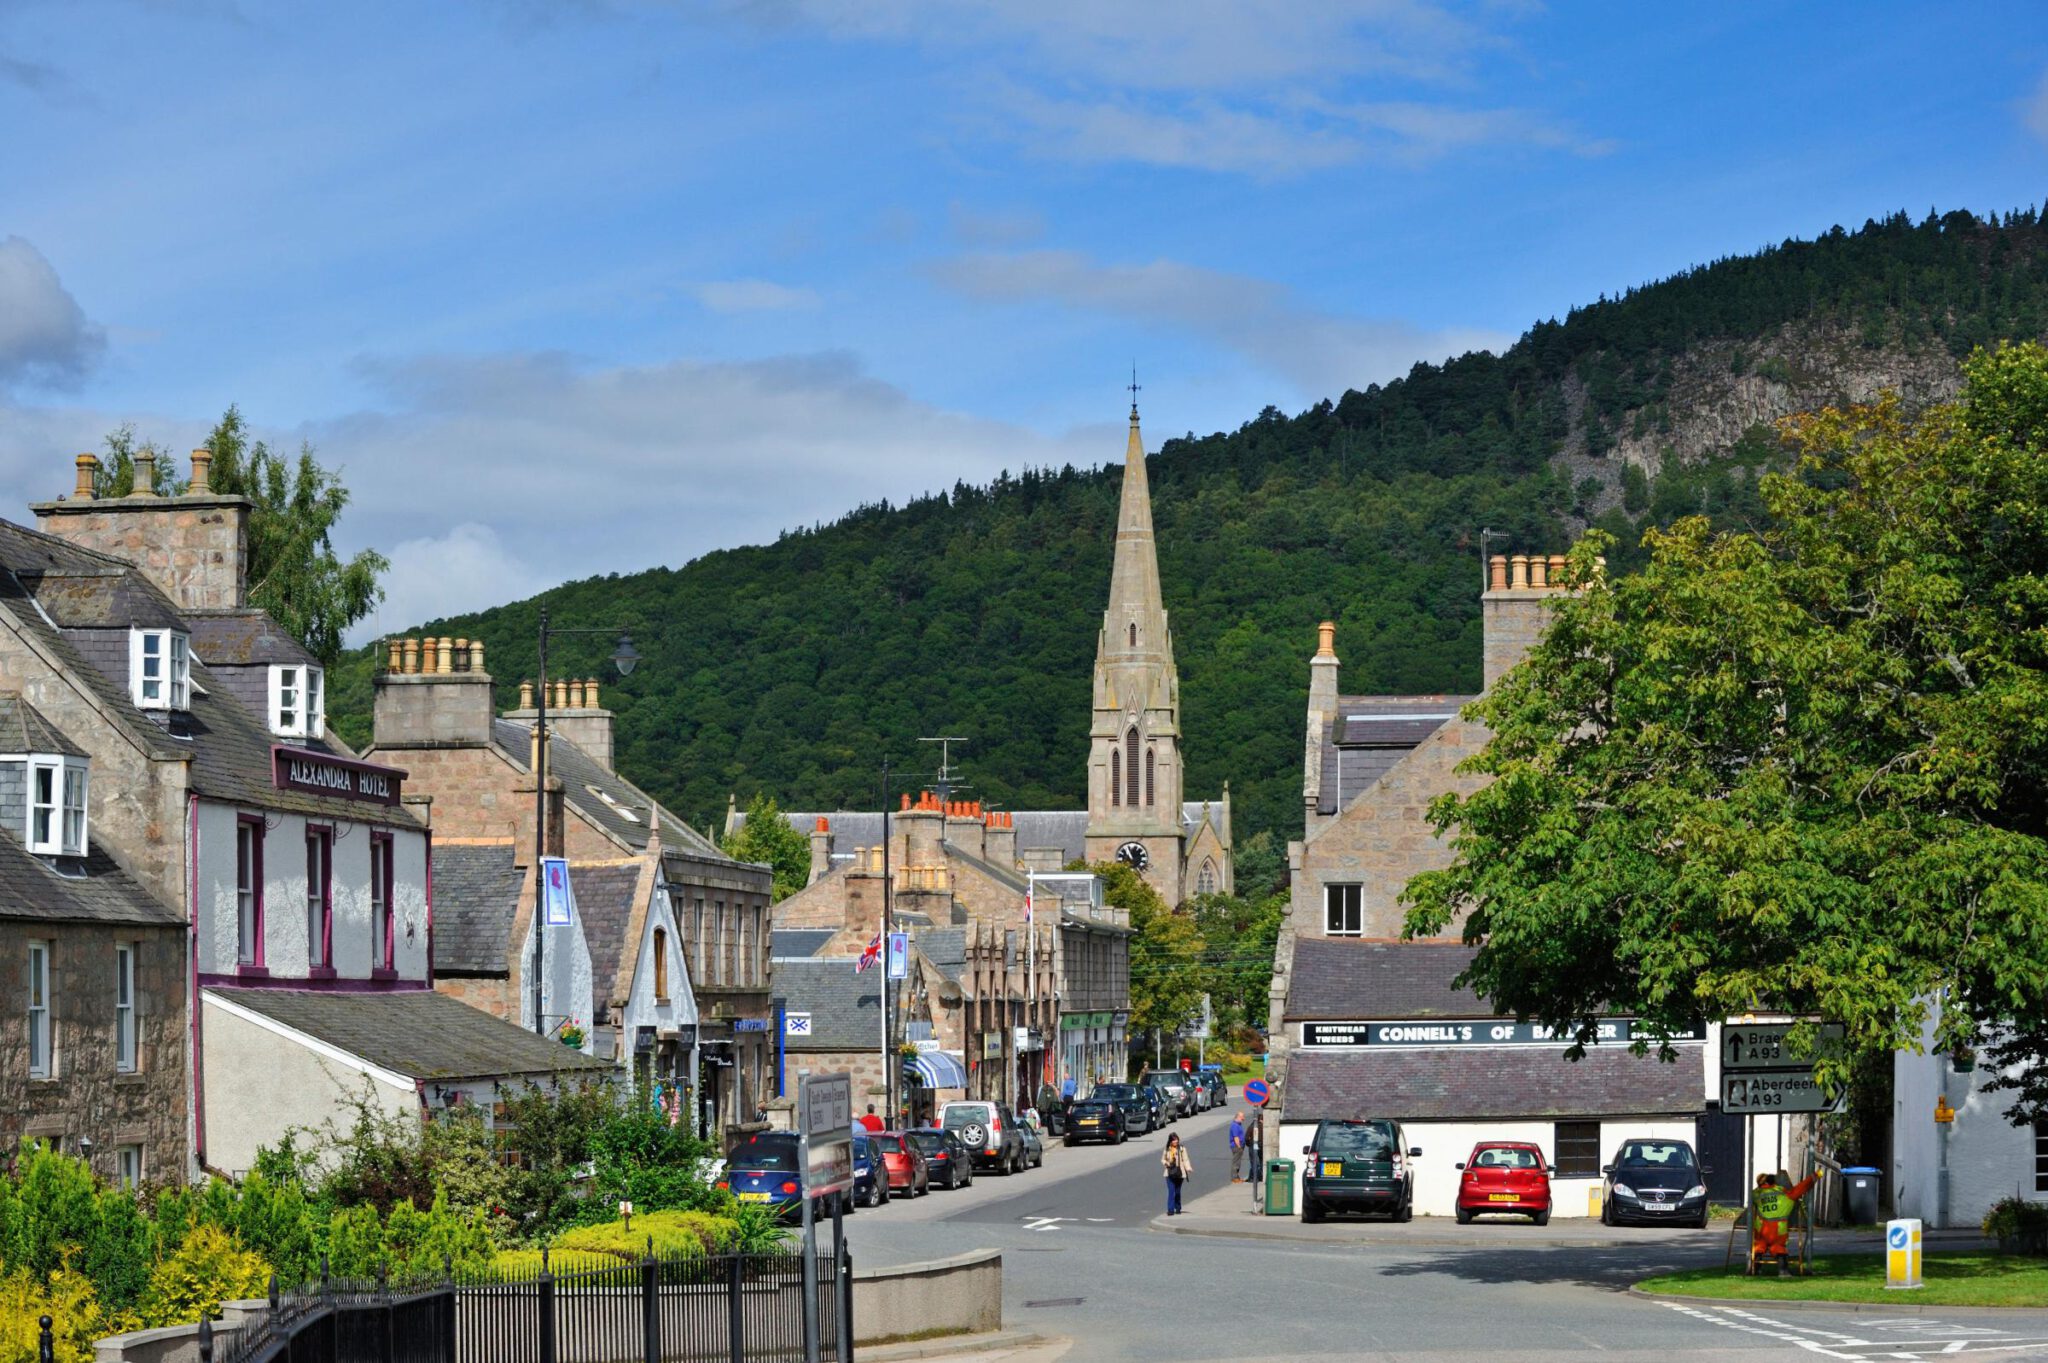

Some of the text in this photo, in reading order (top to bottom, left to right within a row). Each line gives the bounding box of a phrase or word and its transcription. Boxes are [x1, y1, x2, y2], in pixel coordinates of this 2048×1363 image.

[290, 759, 390, 798] ALEXANDRA HOTEL
[1315, 1025, 1366, 1034] KNITWEAR
[1379, 1026, 1473, 1042] CONNELL'S
[1490, 1026, 1515, 1040] OF
[1315, 1035, 1355, 1044] TWEEDS
[1751, 1078, 1818, 1091] Aberdeen
